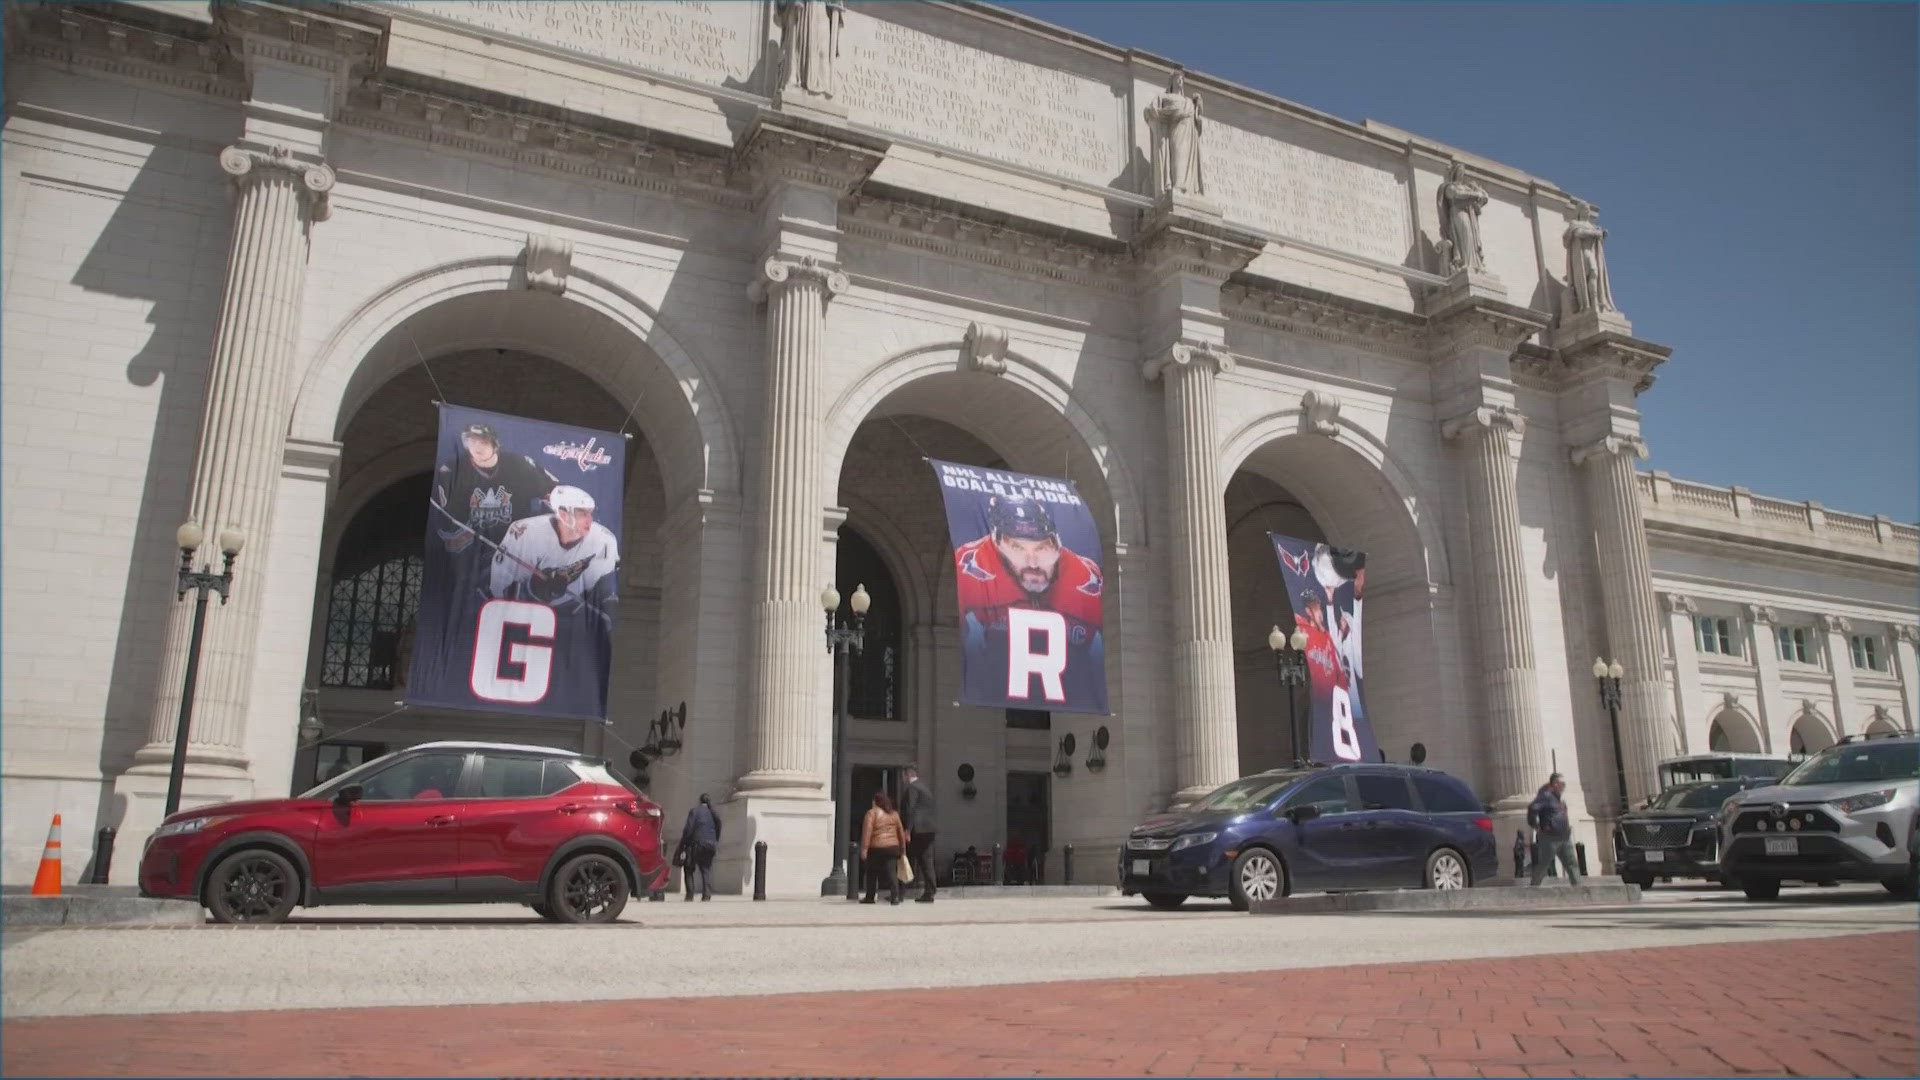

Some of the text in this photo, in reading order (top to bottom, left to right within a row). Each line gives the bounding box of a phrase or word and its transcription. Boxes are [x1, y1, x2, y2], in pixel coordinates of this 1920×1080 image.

[564, 9, 601, 29] OVER
[664, 36, 690, 52] AND
[699, 45, 724, 62] SEA
[573, 23, 602, 41] MAN
[620, 36, 663, 57] ITSELF
[673, 50, 742, 77] UNKNOWN
[691, 19, 736, 41] POWER
[875, 30, 925, 53] BRINGER
[955, 53, 976, 68] LIFE
[853, 45, 881, 62] THE
[886, 55, 957, 83] DAUGHTERS
[986, 83, 1007, 97] TIME
[1019, 92, 1040, 106] AND
[1047, 100, 1095, 122] THOUGHT
[893, 46, 950, 70] FREEDOM
[837, 70, 894, 93] NUMBERS
[906, 89, 929, 103] AND
[897, 75, 972, 105] IMAGINATION
[842, 83, 866, 98] AND
[1017, 130, 1038, 144] AND
[842, 94, 914, 120] PHILOSOPHY
[925, 115, 947, 130] AND
[1009, 138, 1030, 153] AND
[941, 465, 1070, 494] NHL ALL-TIME
[943, 475, 1082, 506] GOALS LEADER
[469, 599, 557, 705] G
[1006, 607, 1068, 703] R
[1332, 684, 1362, 760] 8
